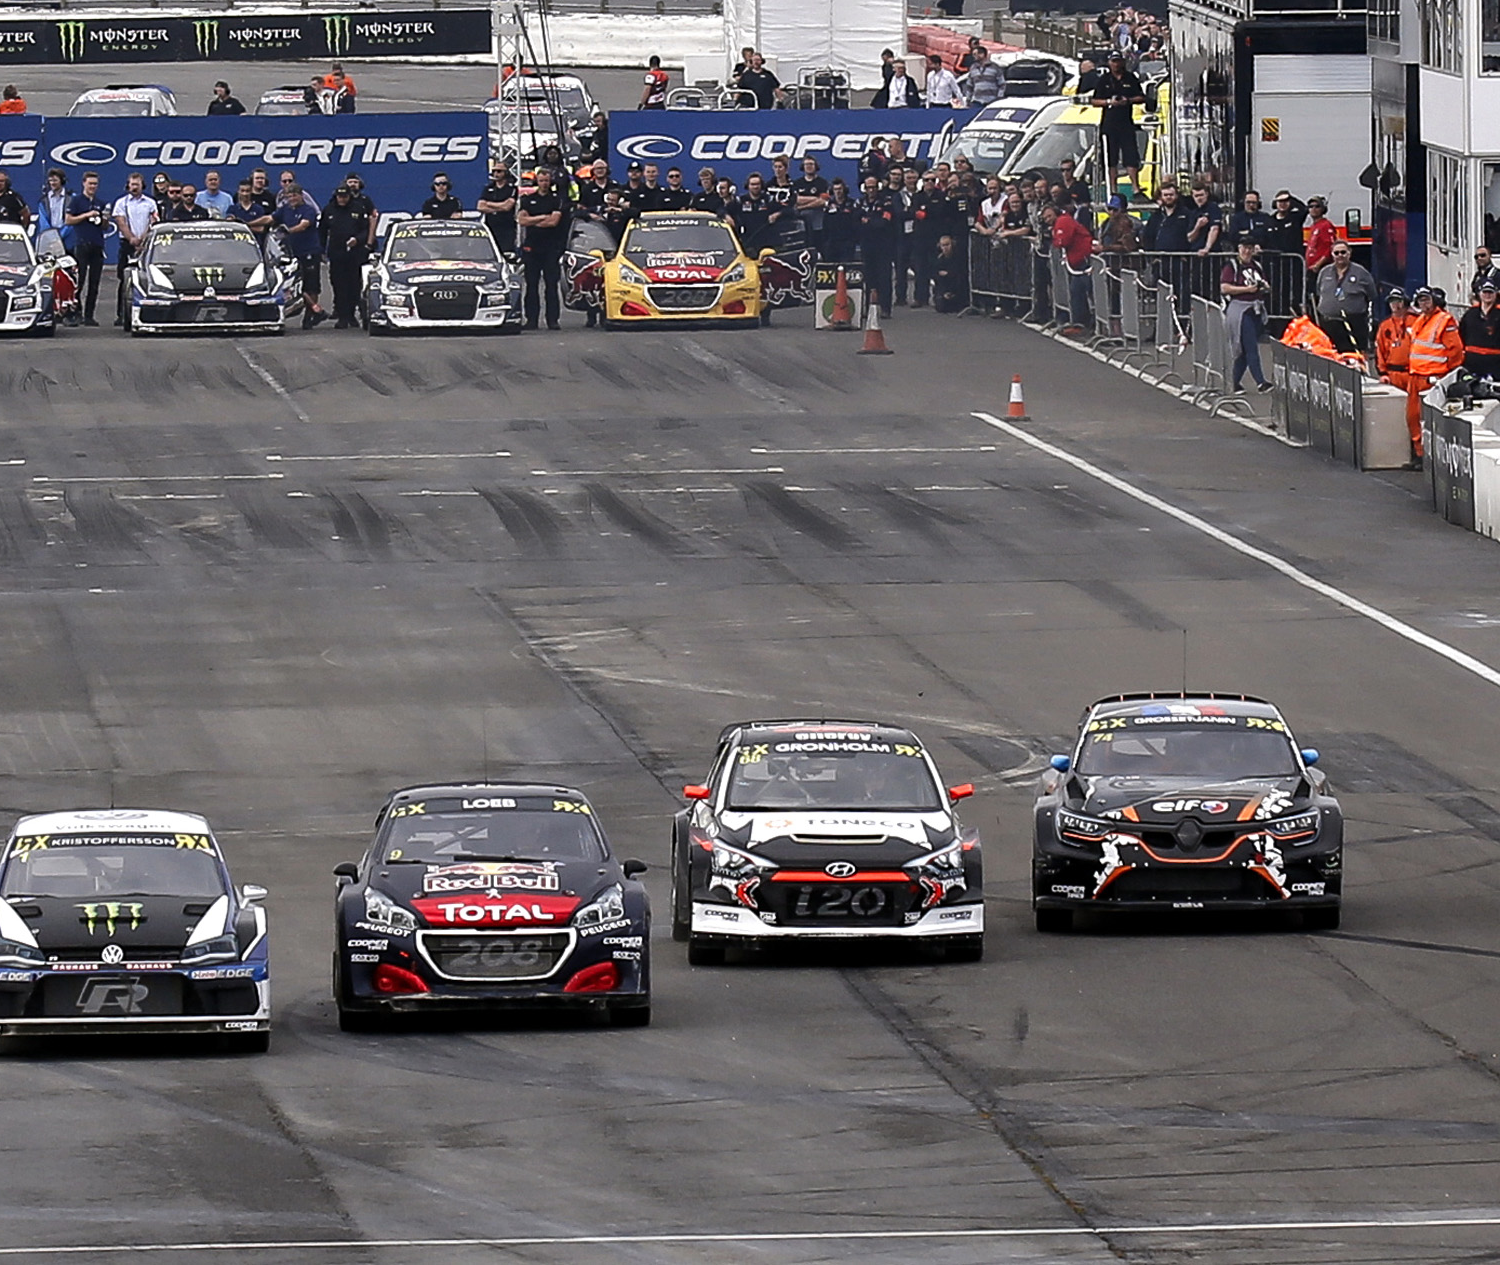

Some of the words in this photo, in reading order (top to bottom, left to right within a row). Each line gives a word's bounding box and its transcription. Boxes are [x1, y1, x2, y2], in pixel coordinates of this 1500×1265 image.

[90, 27, 169, 42] MONSTER
[228, 26, 302, 42] MONSTER
[355, 20, 435, 36] MONSTER
[654, 269, 712, 279] TOTAL
[1093, 733, 1114, 744] 74
[462, 798, 517, 809] LOEB
[1152, 798, 1201, 813] elf
[51, 836, 176, 846] KRISTOFFERSSON
[389, 849, 402, 861] 9
[423, 873, 492, 893] Red
[493, 872, 560, 892] Bull
[794, 886, 886, 916] i20
[437, 902, 555, 922] TOTAL
[355, 921, 412, 937] PEUGEOT
[580, 918, 632, 937] PEUGEOT
[347, 939, 389, 947] COOPER
[603, 936, 643, 946] COOPER
[452, 939, 543, 967] 208
[216, 968, 254, 978] EDGE
[76, 976, 149, 1013] R
